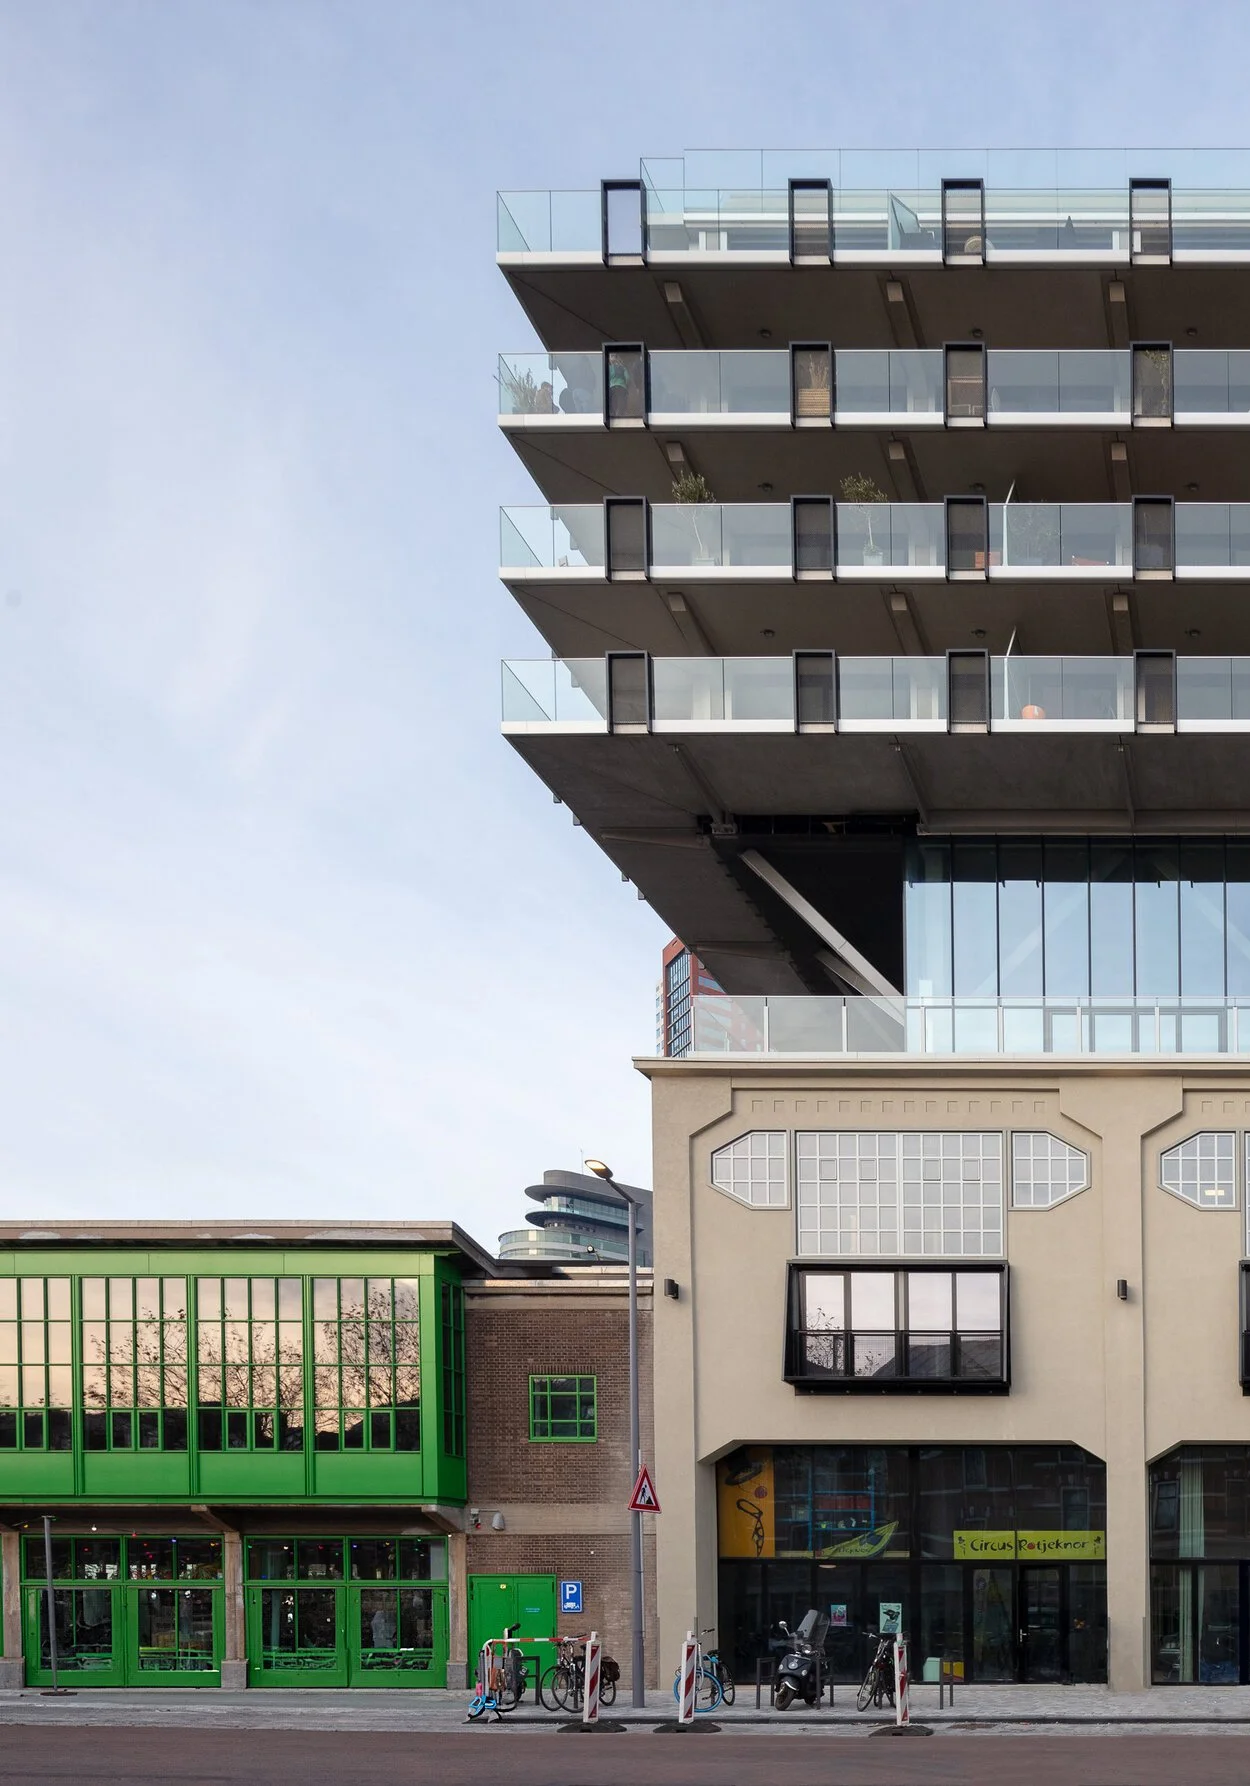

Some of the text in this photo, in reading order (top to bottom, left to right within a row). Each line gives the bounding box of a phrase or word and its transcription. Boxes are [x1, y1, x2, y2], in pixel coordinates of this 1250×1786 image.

[970, 1538, 1088, 1553] Circus Rotjeknor
[566, 1584, 577, 1600] P
